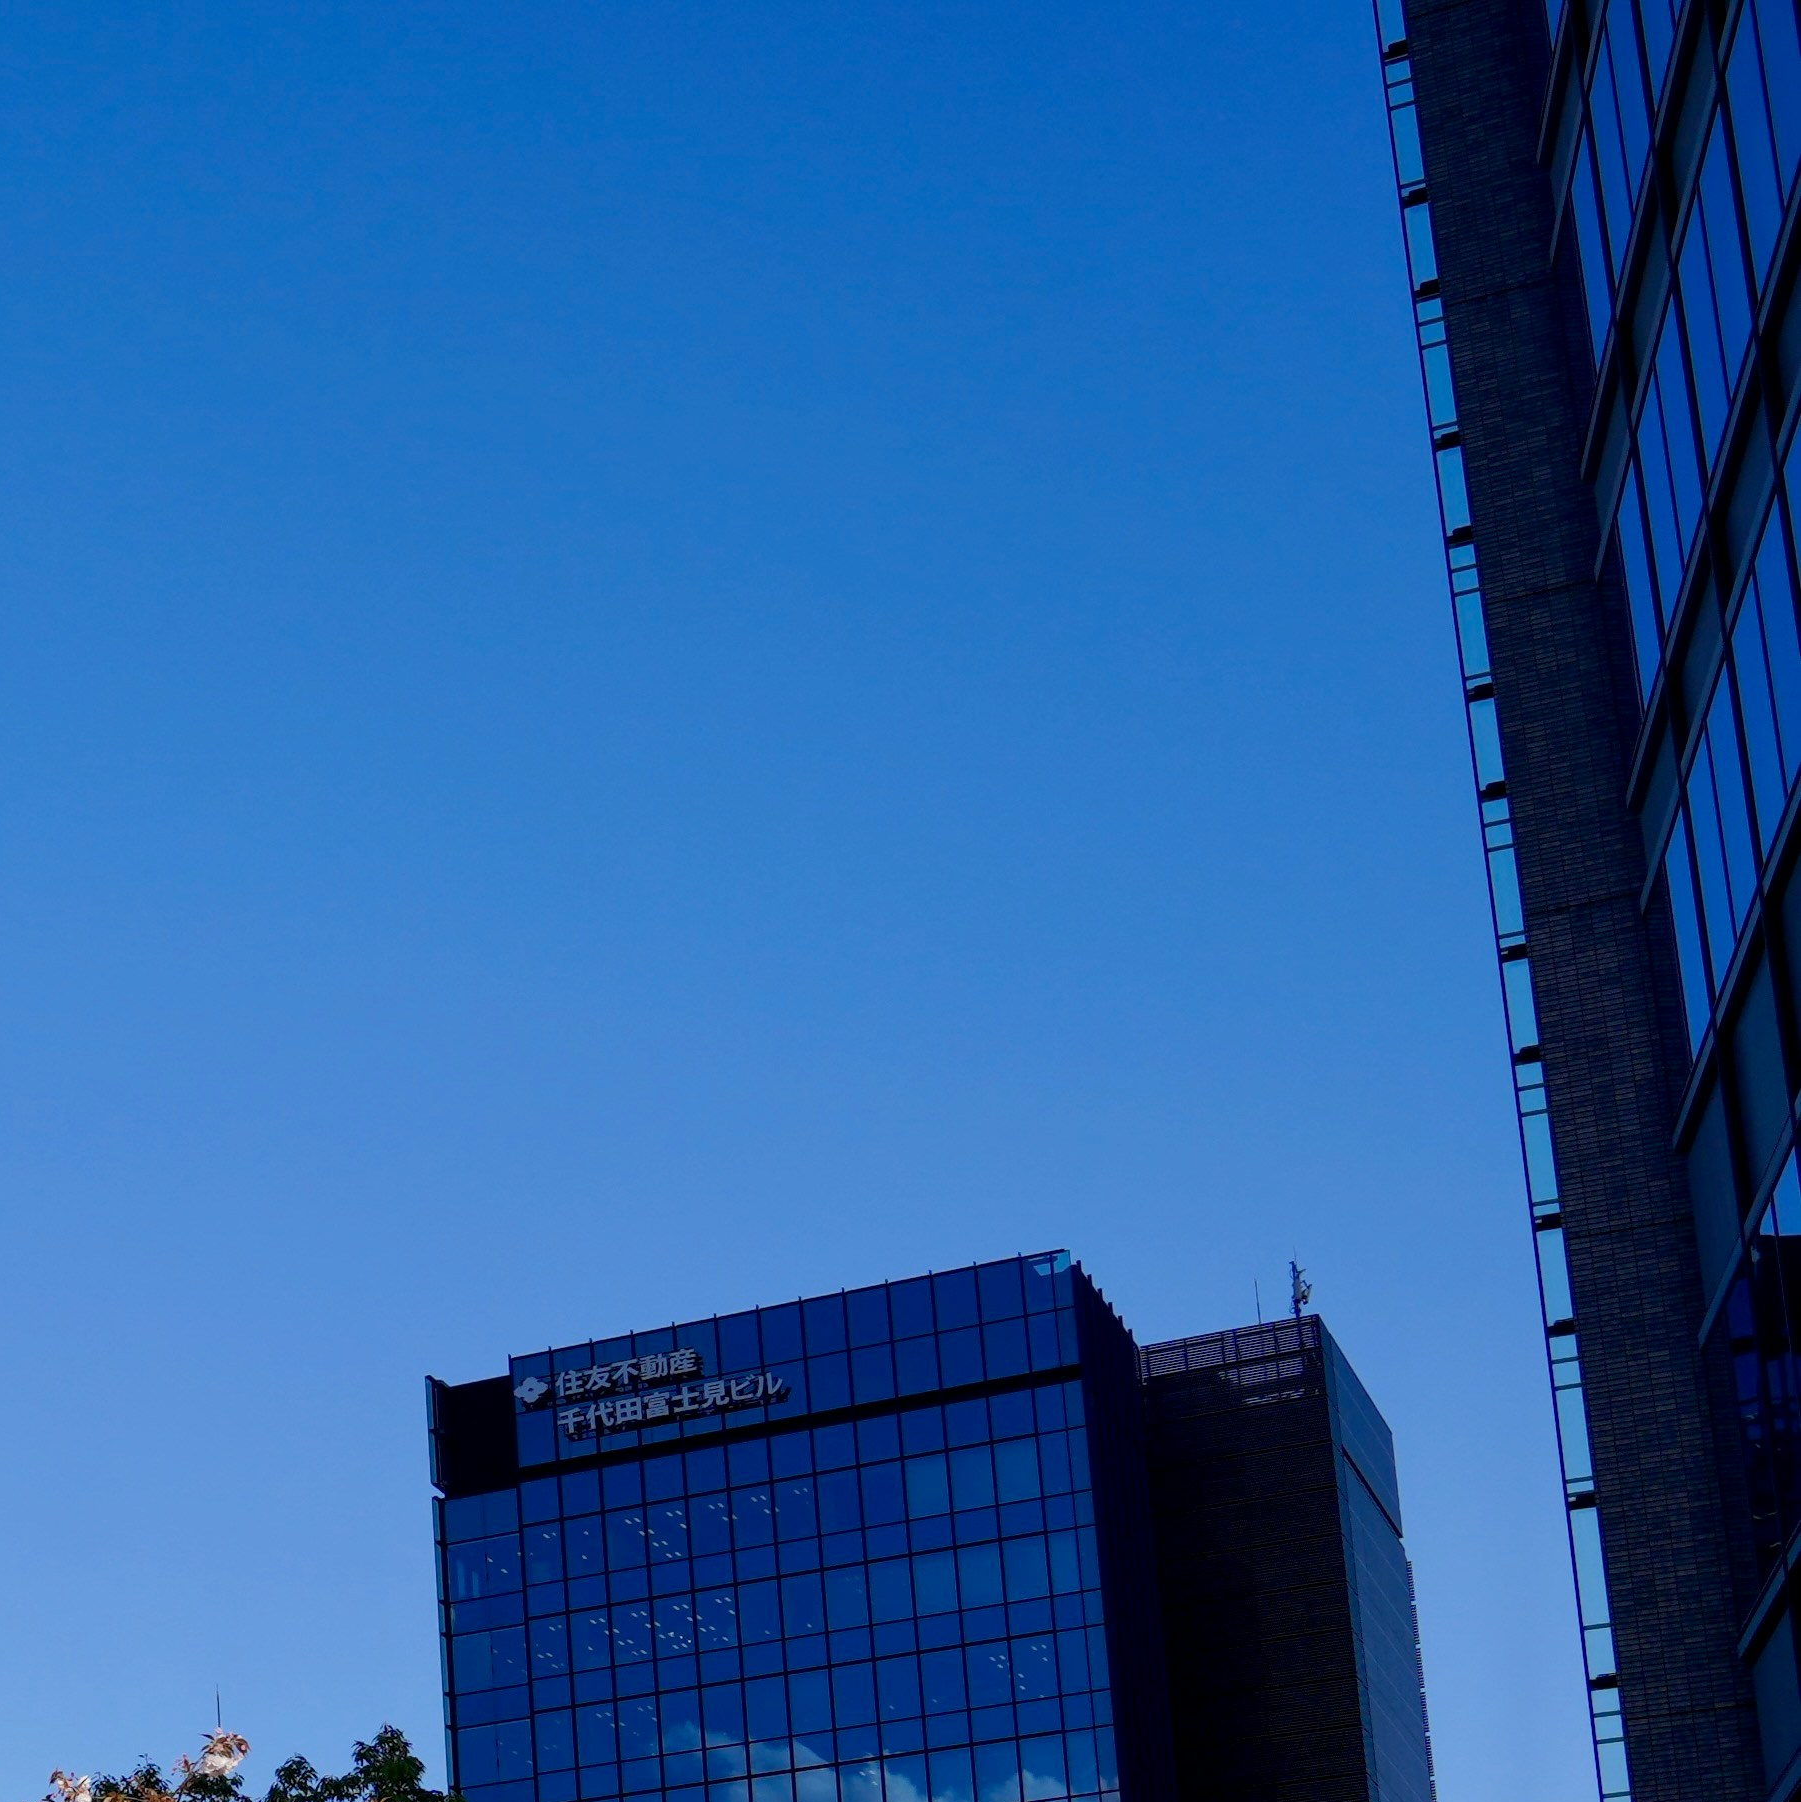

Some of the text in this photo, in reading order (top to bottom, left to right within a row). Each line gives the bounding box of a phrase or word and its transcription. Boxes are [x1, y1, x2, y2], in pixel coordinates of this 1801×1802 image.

[555, 1348, 697, 1397] 住友不動産
[557, 1371, 784, 1435] 千代田富士見ビル
